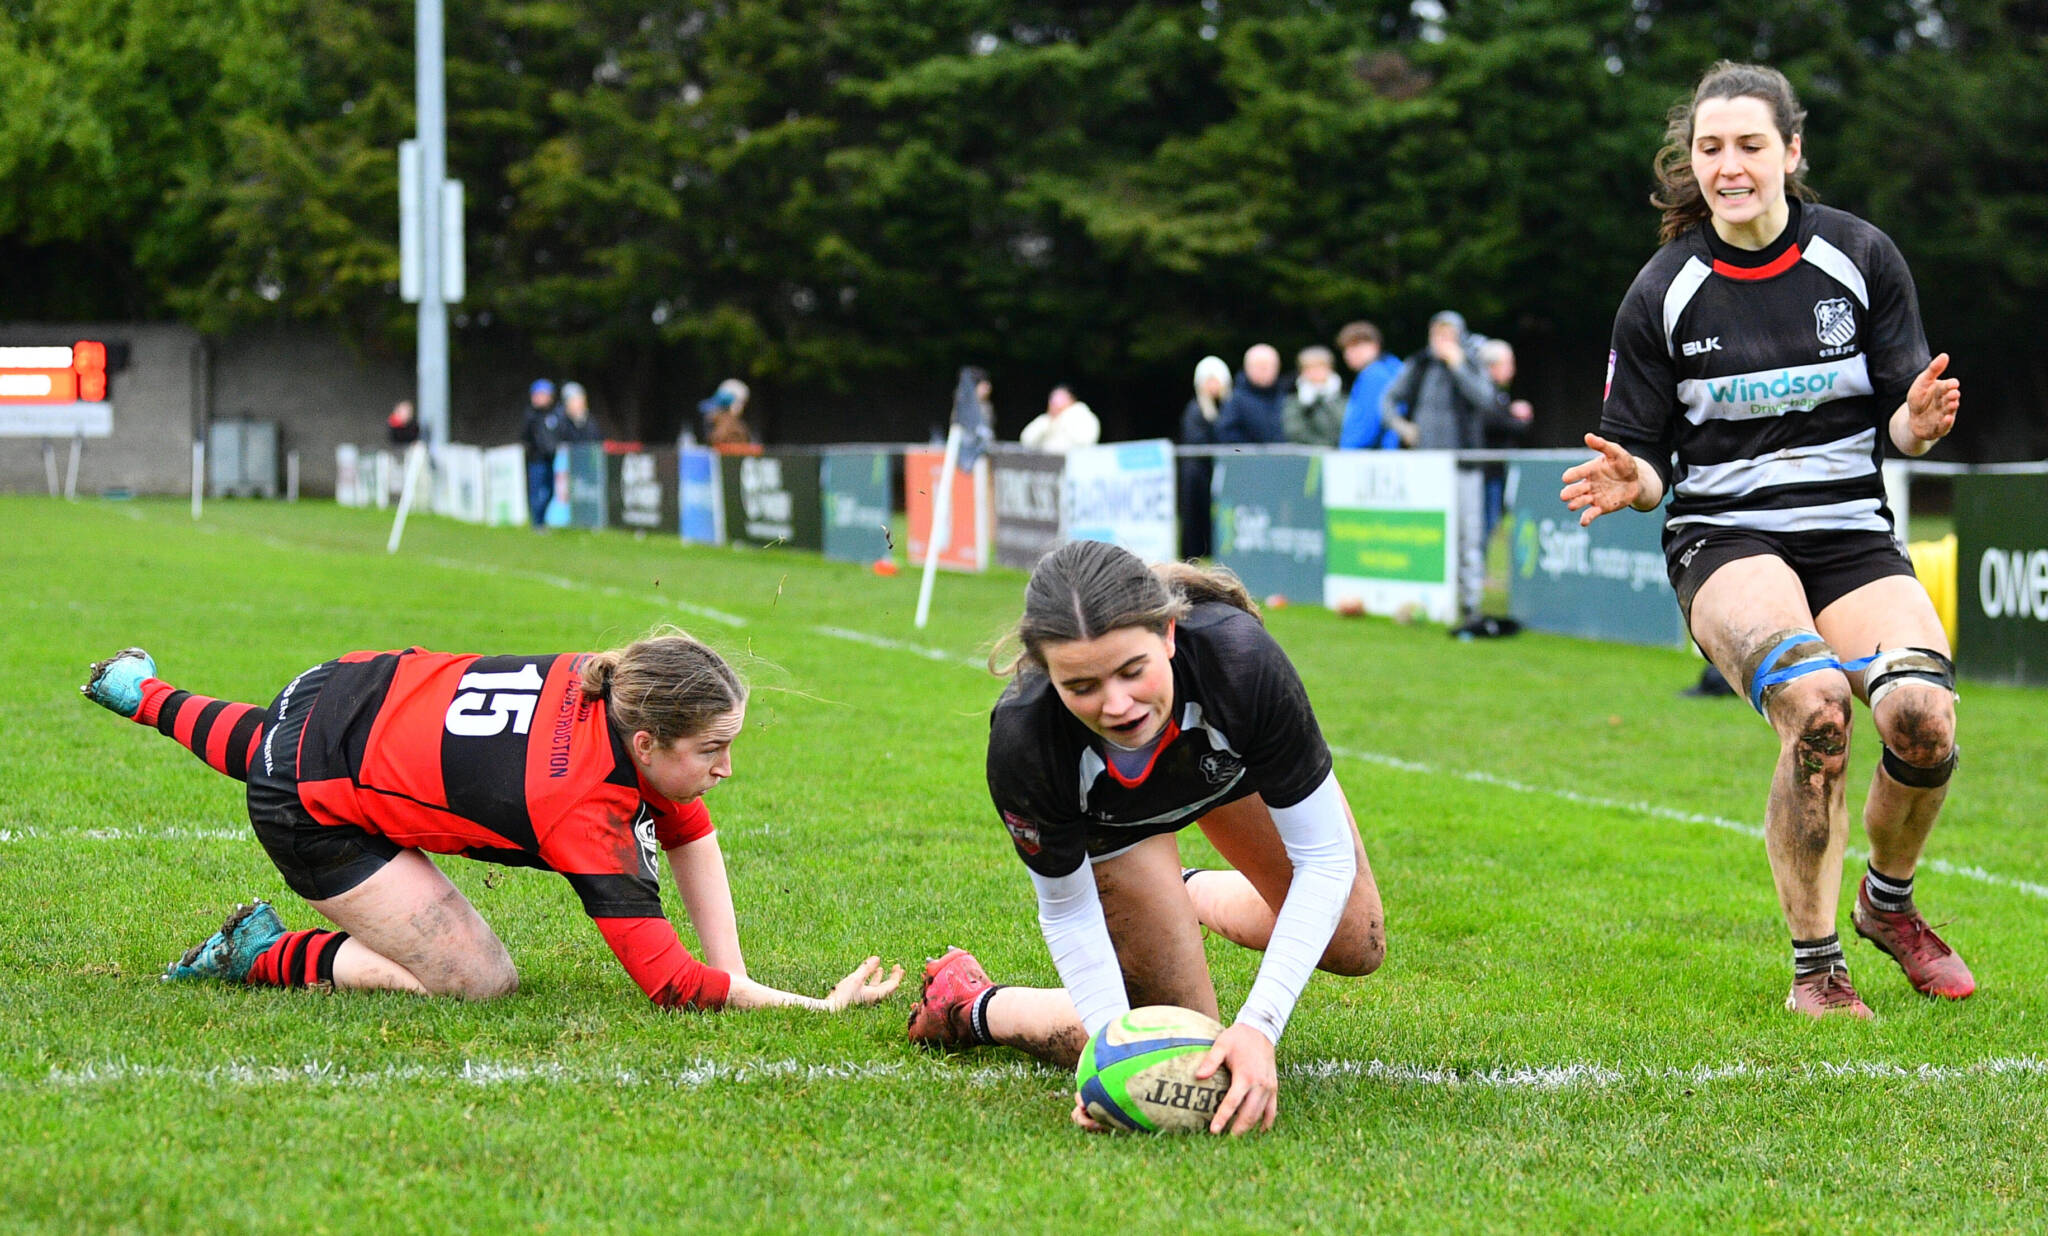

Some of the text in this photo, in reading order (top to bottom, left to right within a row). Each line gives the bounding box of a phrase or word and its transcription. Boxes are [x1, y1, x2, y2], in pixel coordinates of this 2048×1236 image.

[1682, 336, 1722, 357] BLK
[1707, 371, 1838, 404] Windsor
[445, 663, 544, 737] 15
